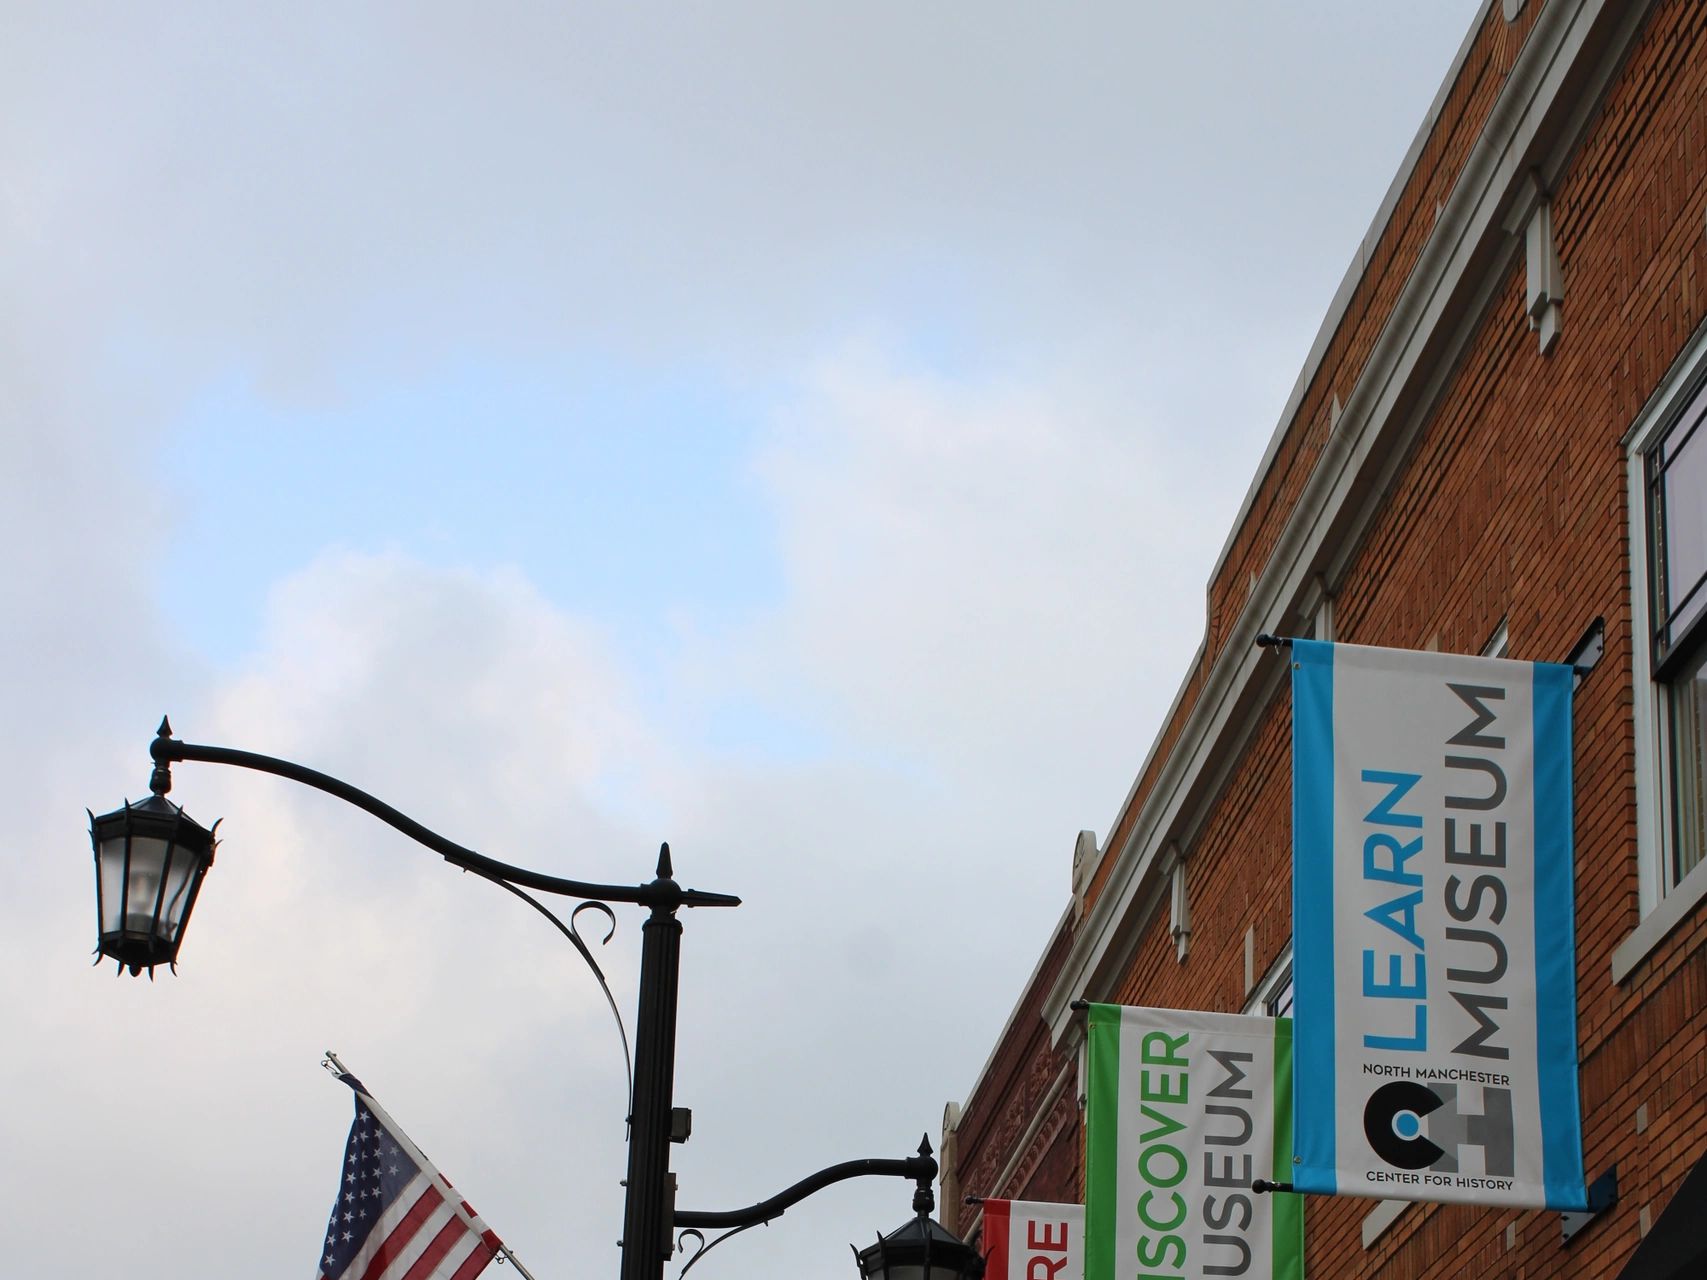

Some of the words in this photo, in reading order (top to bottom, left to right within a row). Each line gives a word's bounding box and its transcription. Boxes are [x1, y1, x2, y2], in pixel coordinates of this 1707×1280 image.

[1361, 769, 1427, 1052] LEARN
[1444, 682, 1510, 1061] MUSEUM
[1363, 1063, 1411, 1078] NORTH
[1416, 1068, 1510, 1086] MANCHESTER
[1366, 1171, 1420, 1184] CENTER
[1424, 1175, 1451, 1186] FOR
[1456, 1178, 1513, 1190] HISTORY
